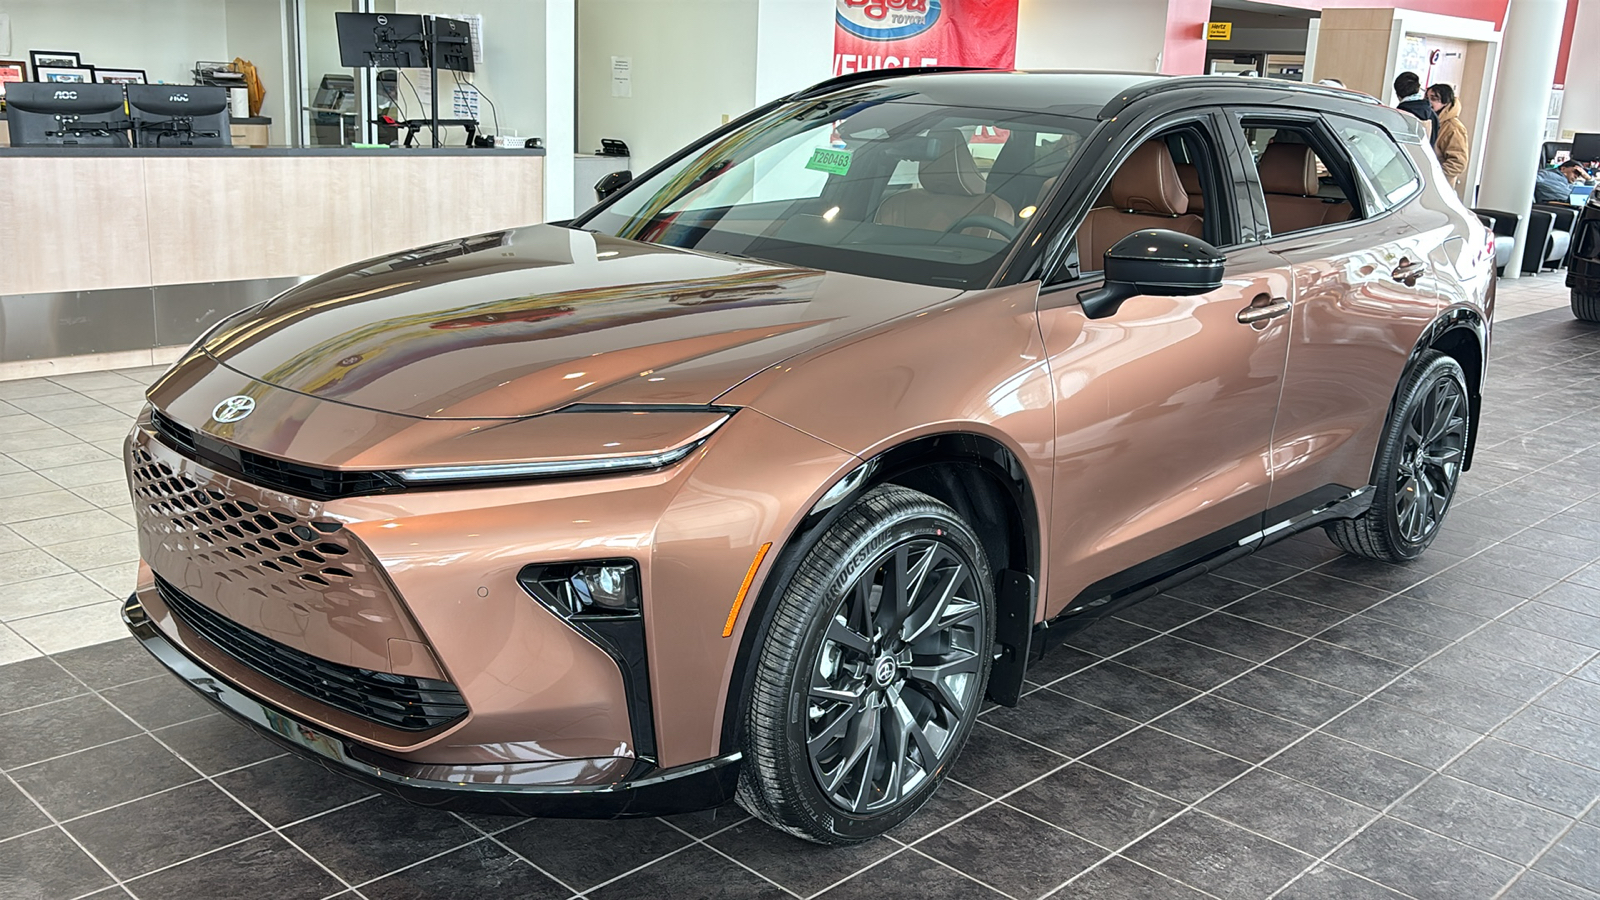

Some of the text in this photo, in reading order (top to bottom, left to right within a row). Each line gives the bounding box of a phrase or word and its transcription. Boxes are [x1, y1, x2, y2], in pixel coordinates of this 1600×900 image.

[891, 14, 926, 25] TOYOTA
[54, 91, 78, 100] AOC
[813, 151, 850, 167] T260463
[820, 527, 893, 611] BRIDGESTONE
